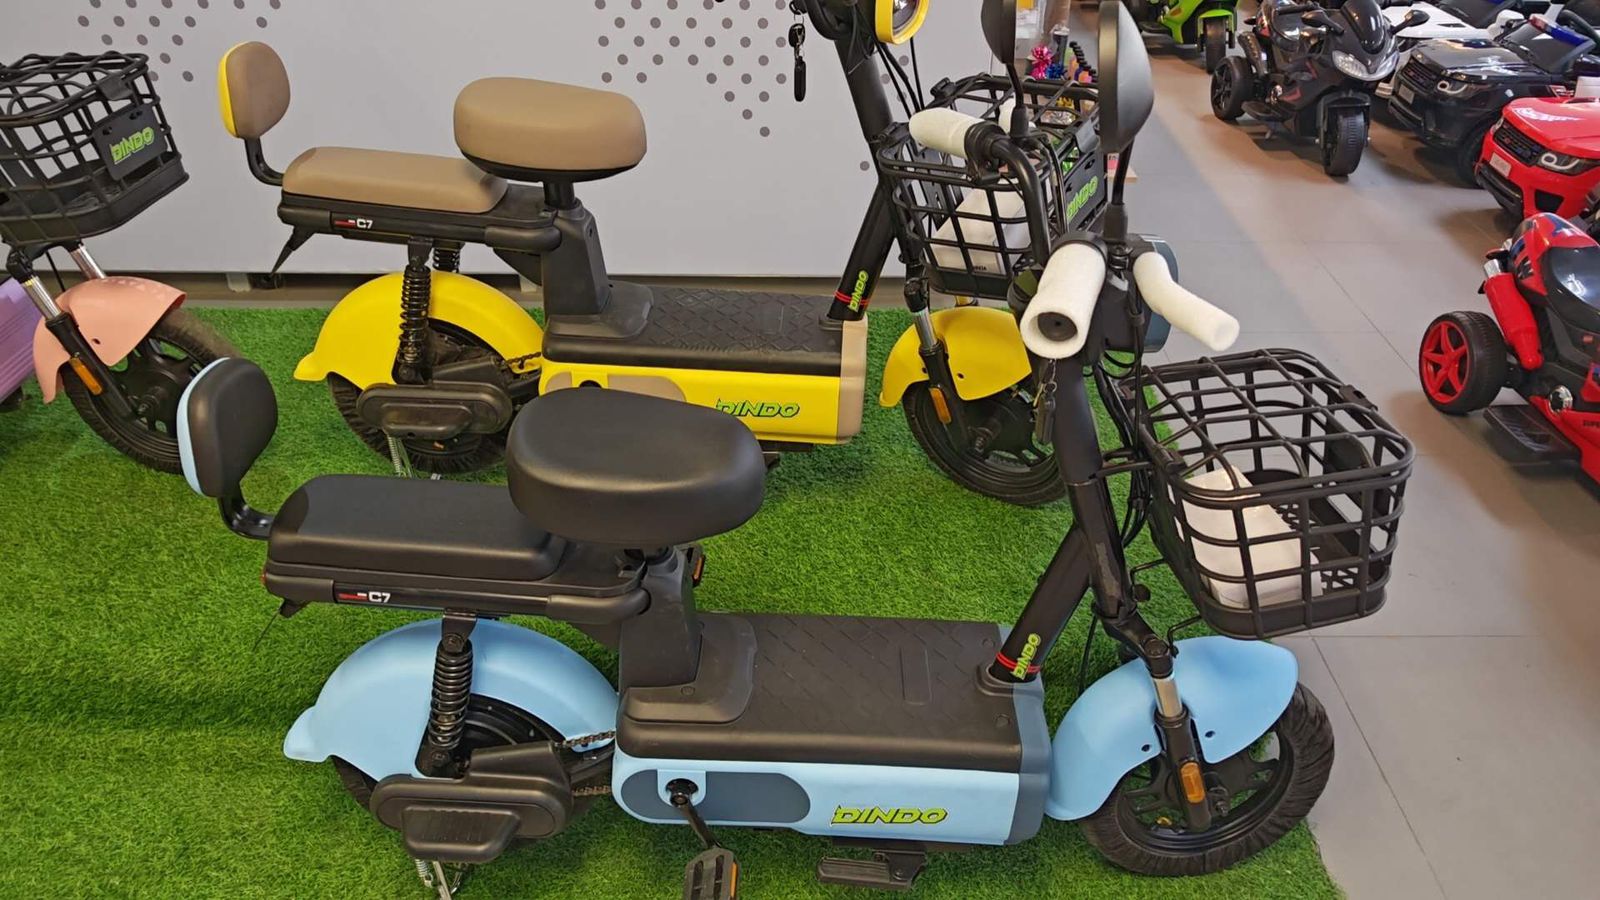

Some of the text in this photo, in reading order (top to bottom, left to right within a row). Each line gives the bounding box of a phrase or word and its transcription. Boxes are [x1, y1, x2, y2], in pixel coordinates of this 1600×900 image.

[109, 127, 154, 164] DINDO
[357, 218, 373, 229] C7
[848, 270, 869, 313] DINDO
[716, 398, 800, 418] DINDO
[368, 591, 391, 603] C7
[1010, 633, 1041, 680] DINDO
[830, 805, 949, 826] DINDO
